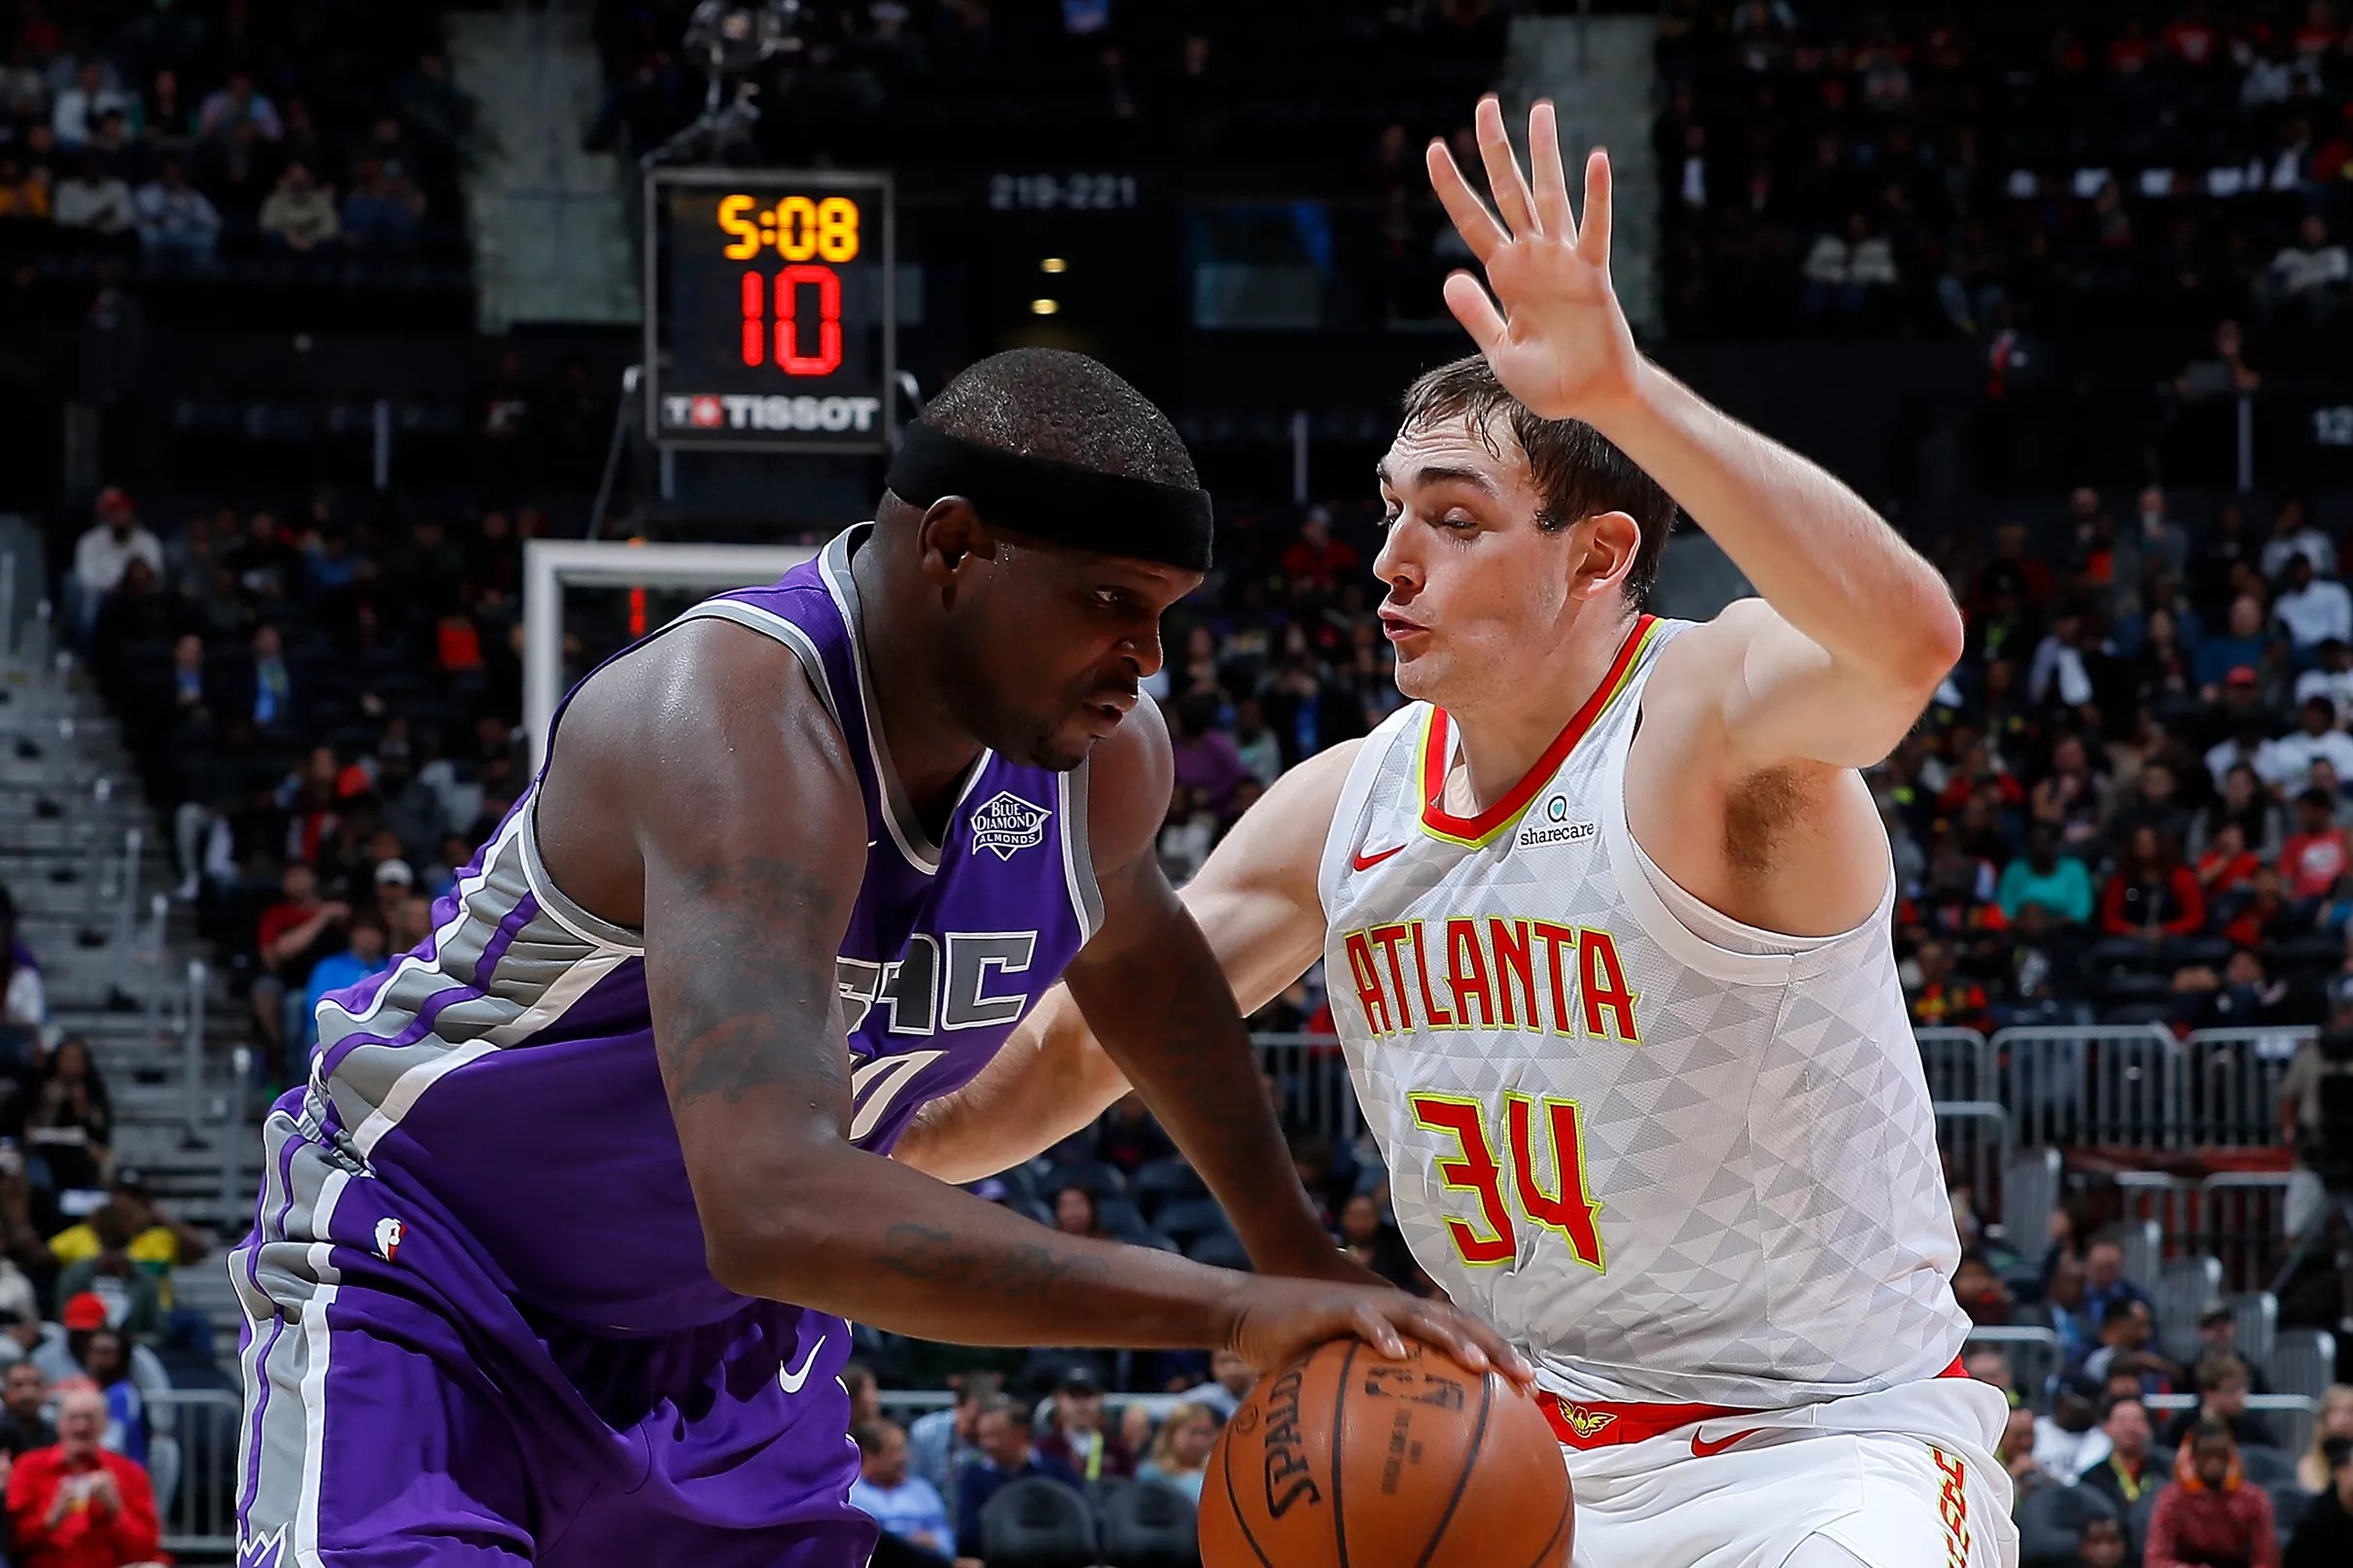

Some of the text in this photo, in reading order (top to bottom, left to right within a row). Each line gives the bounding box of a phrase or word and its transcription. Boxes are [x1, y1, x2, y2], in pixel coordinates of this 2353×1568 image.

[718, 194, 860, 262] 5:08
[742, 264, 842, 375] 10
[722, 394, 880, 431] TISSOT
[976, 812, 1037, 831] DIAMOND
[992, 801, 1022, 818] BLUE
[1520, 822, 1595, 846] sharecare
[979, 833, 1036, 845] ALMONDS
[1343, 915, 1642, 1045] ATLANTA
[1407, 1090, 1606, 1275] 34
[1264, 1359, 1322, 1520] SPALD
